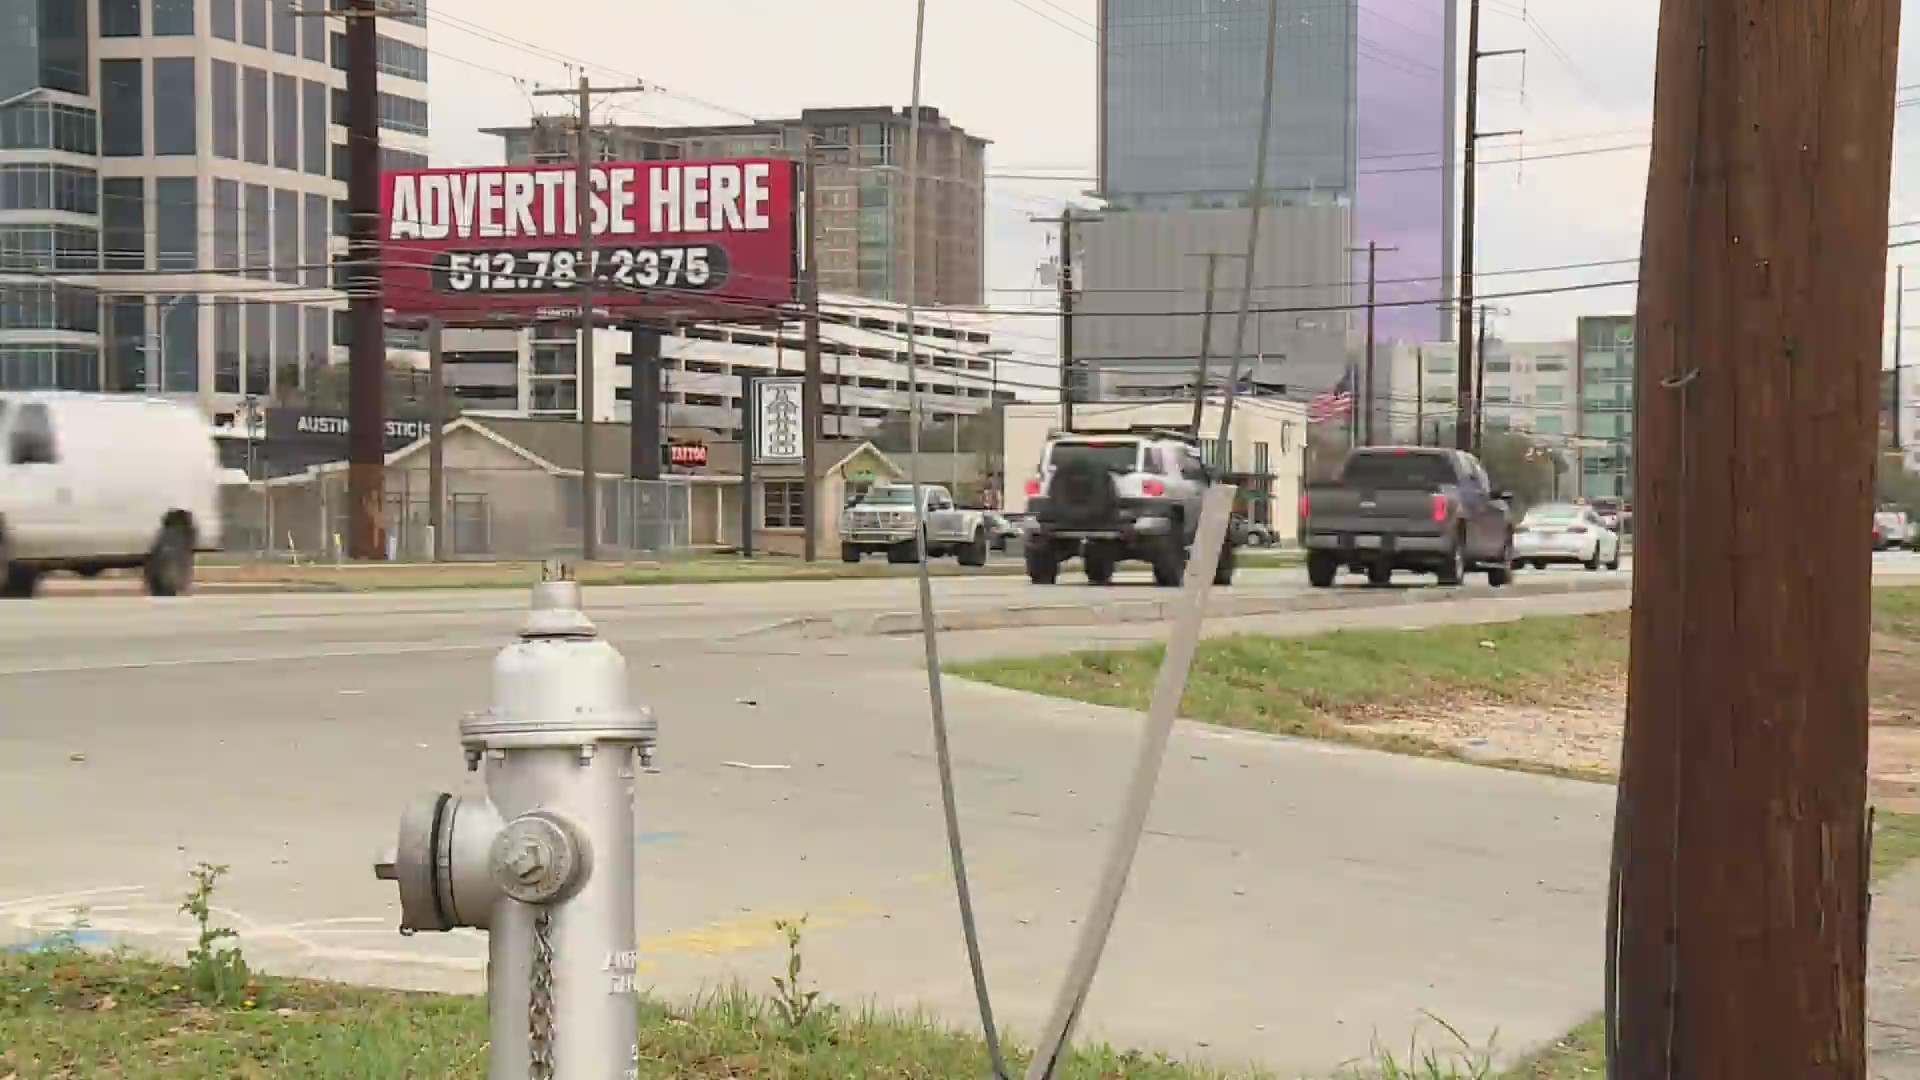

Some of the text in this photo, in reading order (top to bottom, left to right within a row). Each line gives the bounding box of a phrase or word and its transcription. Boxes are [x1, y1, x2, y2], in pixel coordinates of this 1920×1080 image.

[389, 163, 770, 240] ADVERTISE HERE
[298, 416, 350, 433] AUSTIN
[671, 446, 706, 461] TATTOO
